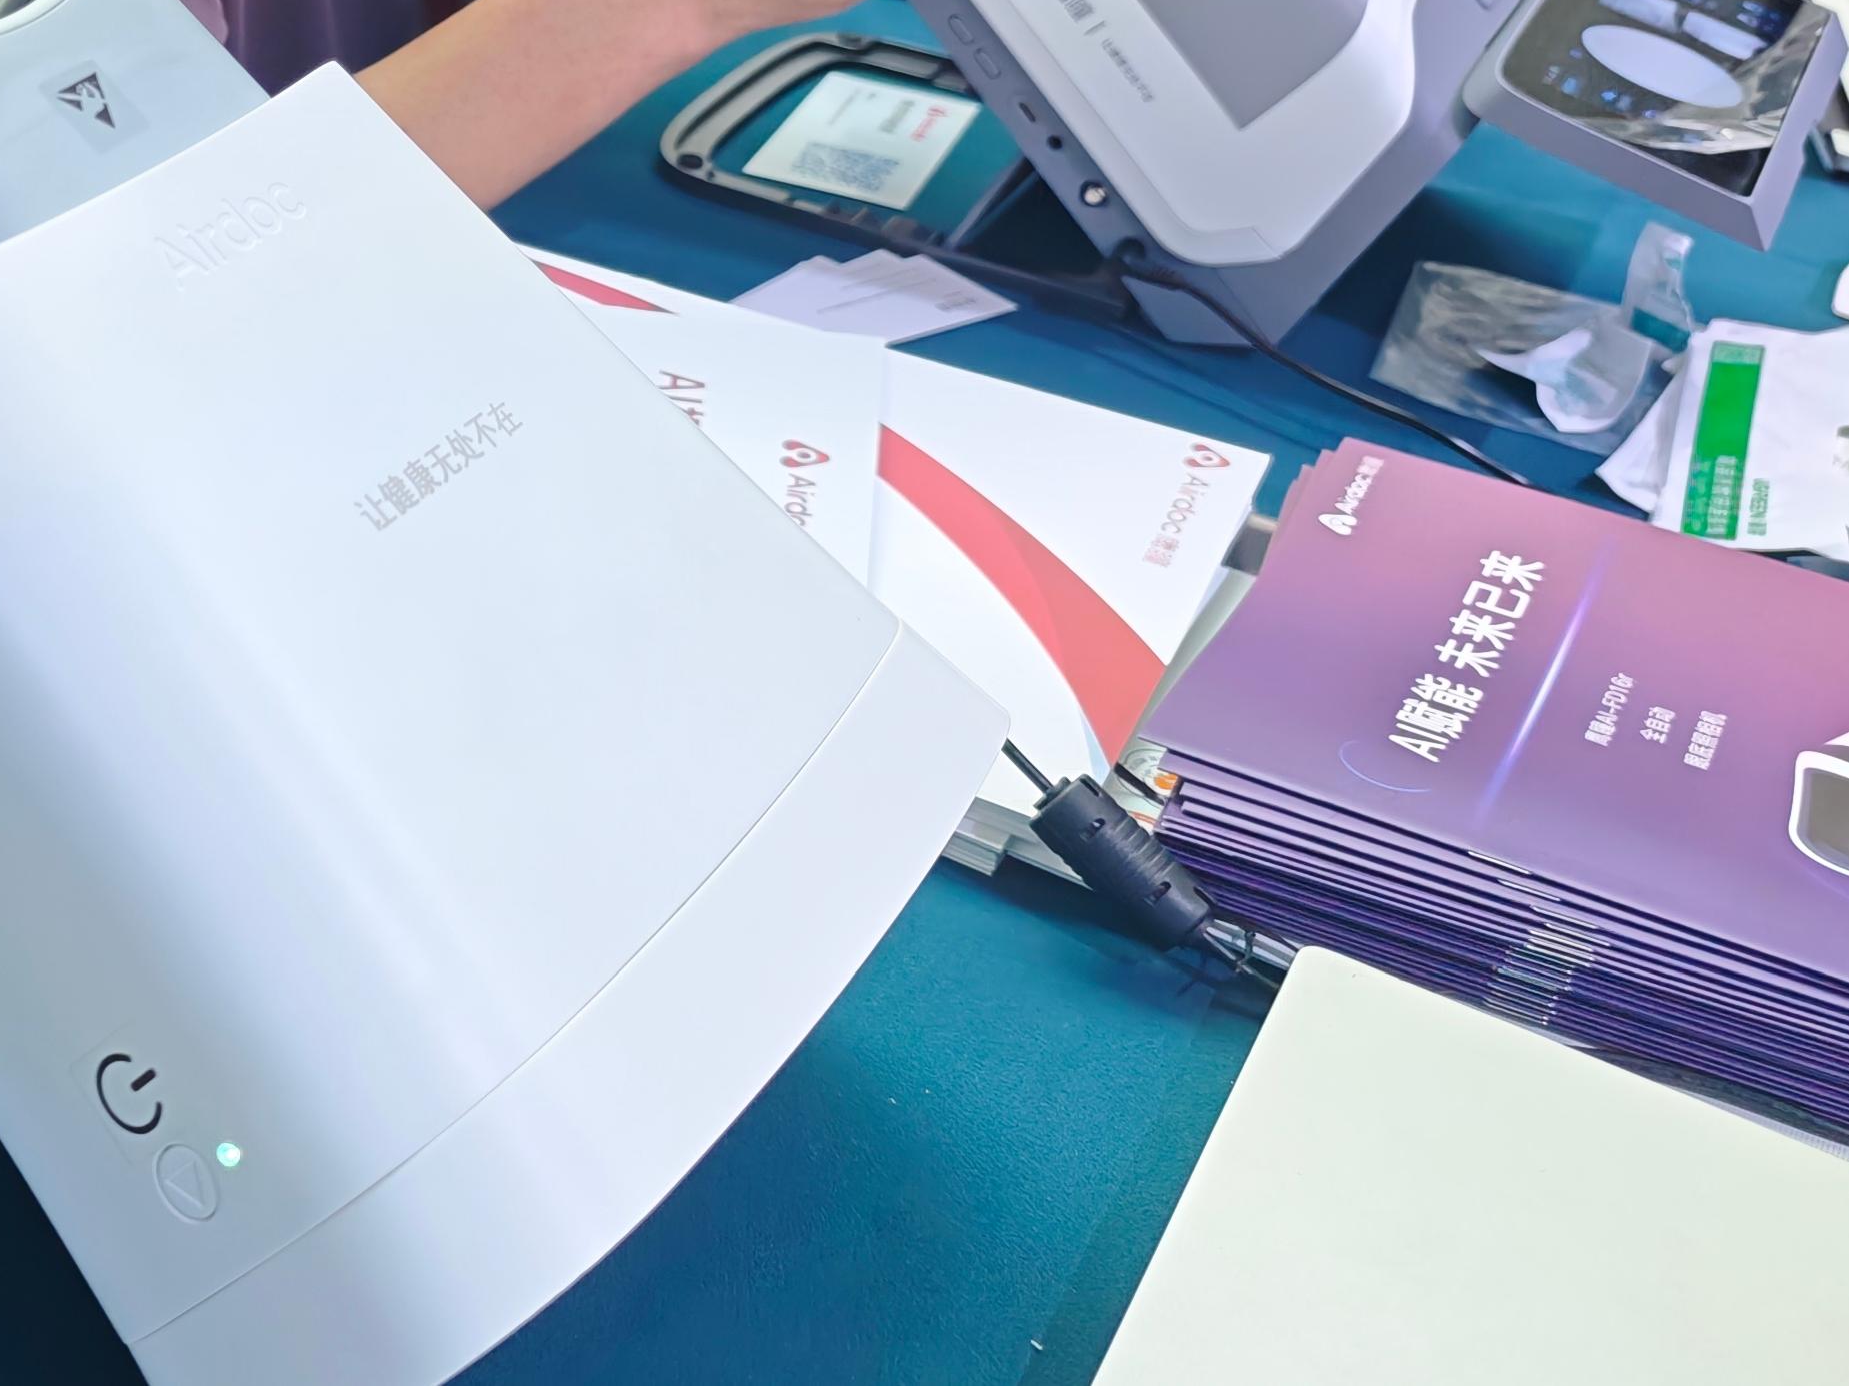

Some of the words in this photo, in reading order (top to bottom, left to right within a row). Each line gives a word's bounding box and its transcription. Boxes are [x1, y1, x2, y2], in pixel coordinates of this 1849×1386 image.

[154, 181, 307, 292] Airdoc
[353, 400, 524, 532] 让健康无处不在
[1160, 472, 1210, 537] Airdoc
[1434, 550, 1546, 678] 未来已来
[1388, 673, 1484, 763] AI赋能
[1639, 706, 1676, 744] 全自动
